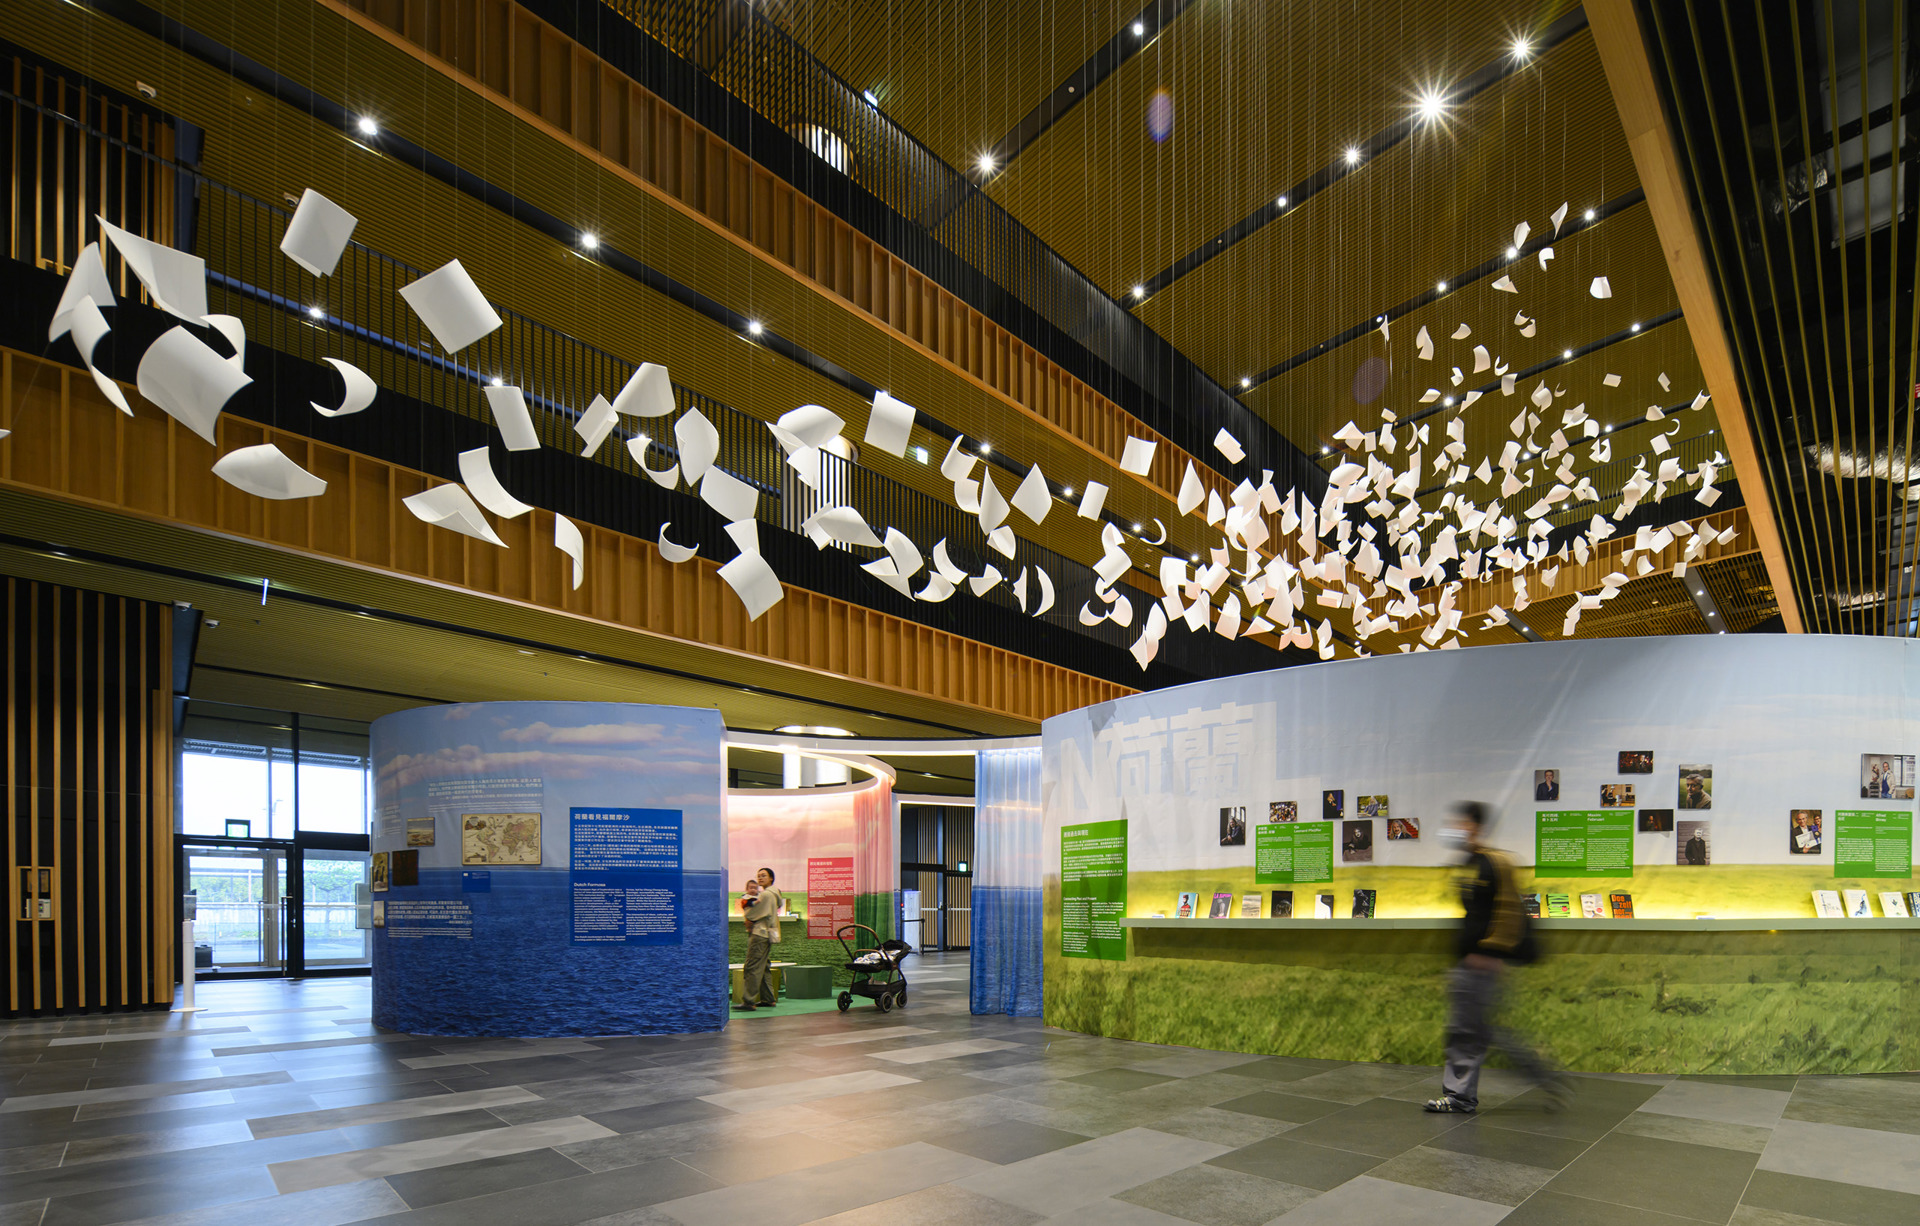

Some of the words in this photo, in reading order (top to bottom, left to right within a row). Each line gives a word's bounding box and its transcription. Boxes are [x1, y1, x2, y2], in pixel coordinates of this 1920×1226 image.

[1099, 701, 1253, 799] 荷蘭
[574, 813, 630, 821] 荷蘭看見福爾摩沙
[1611, 894, 1625, 902] Doe
